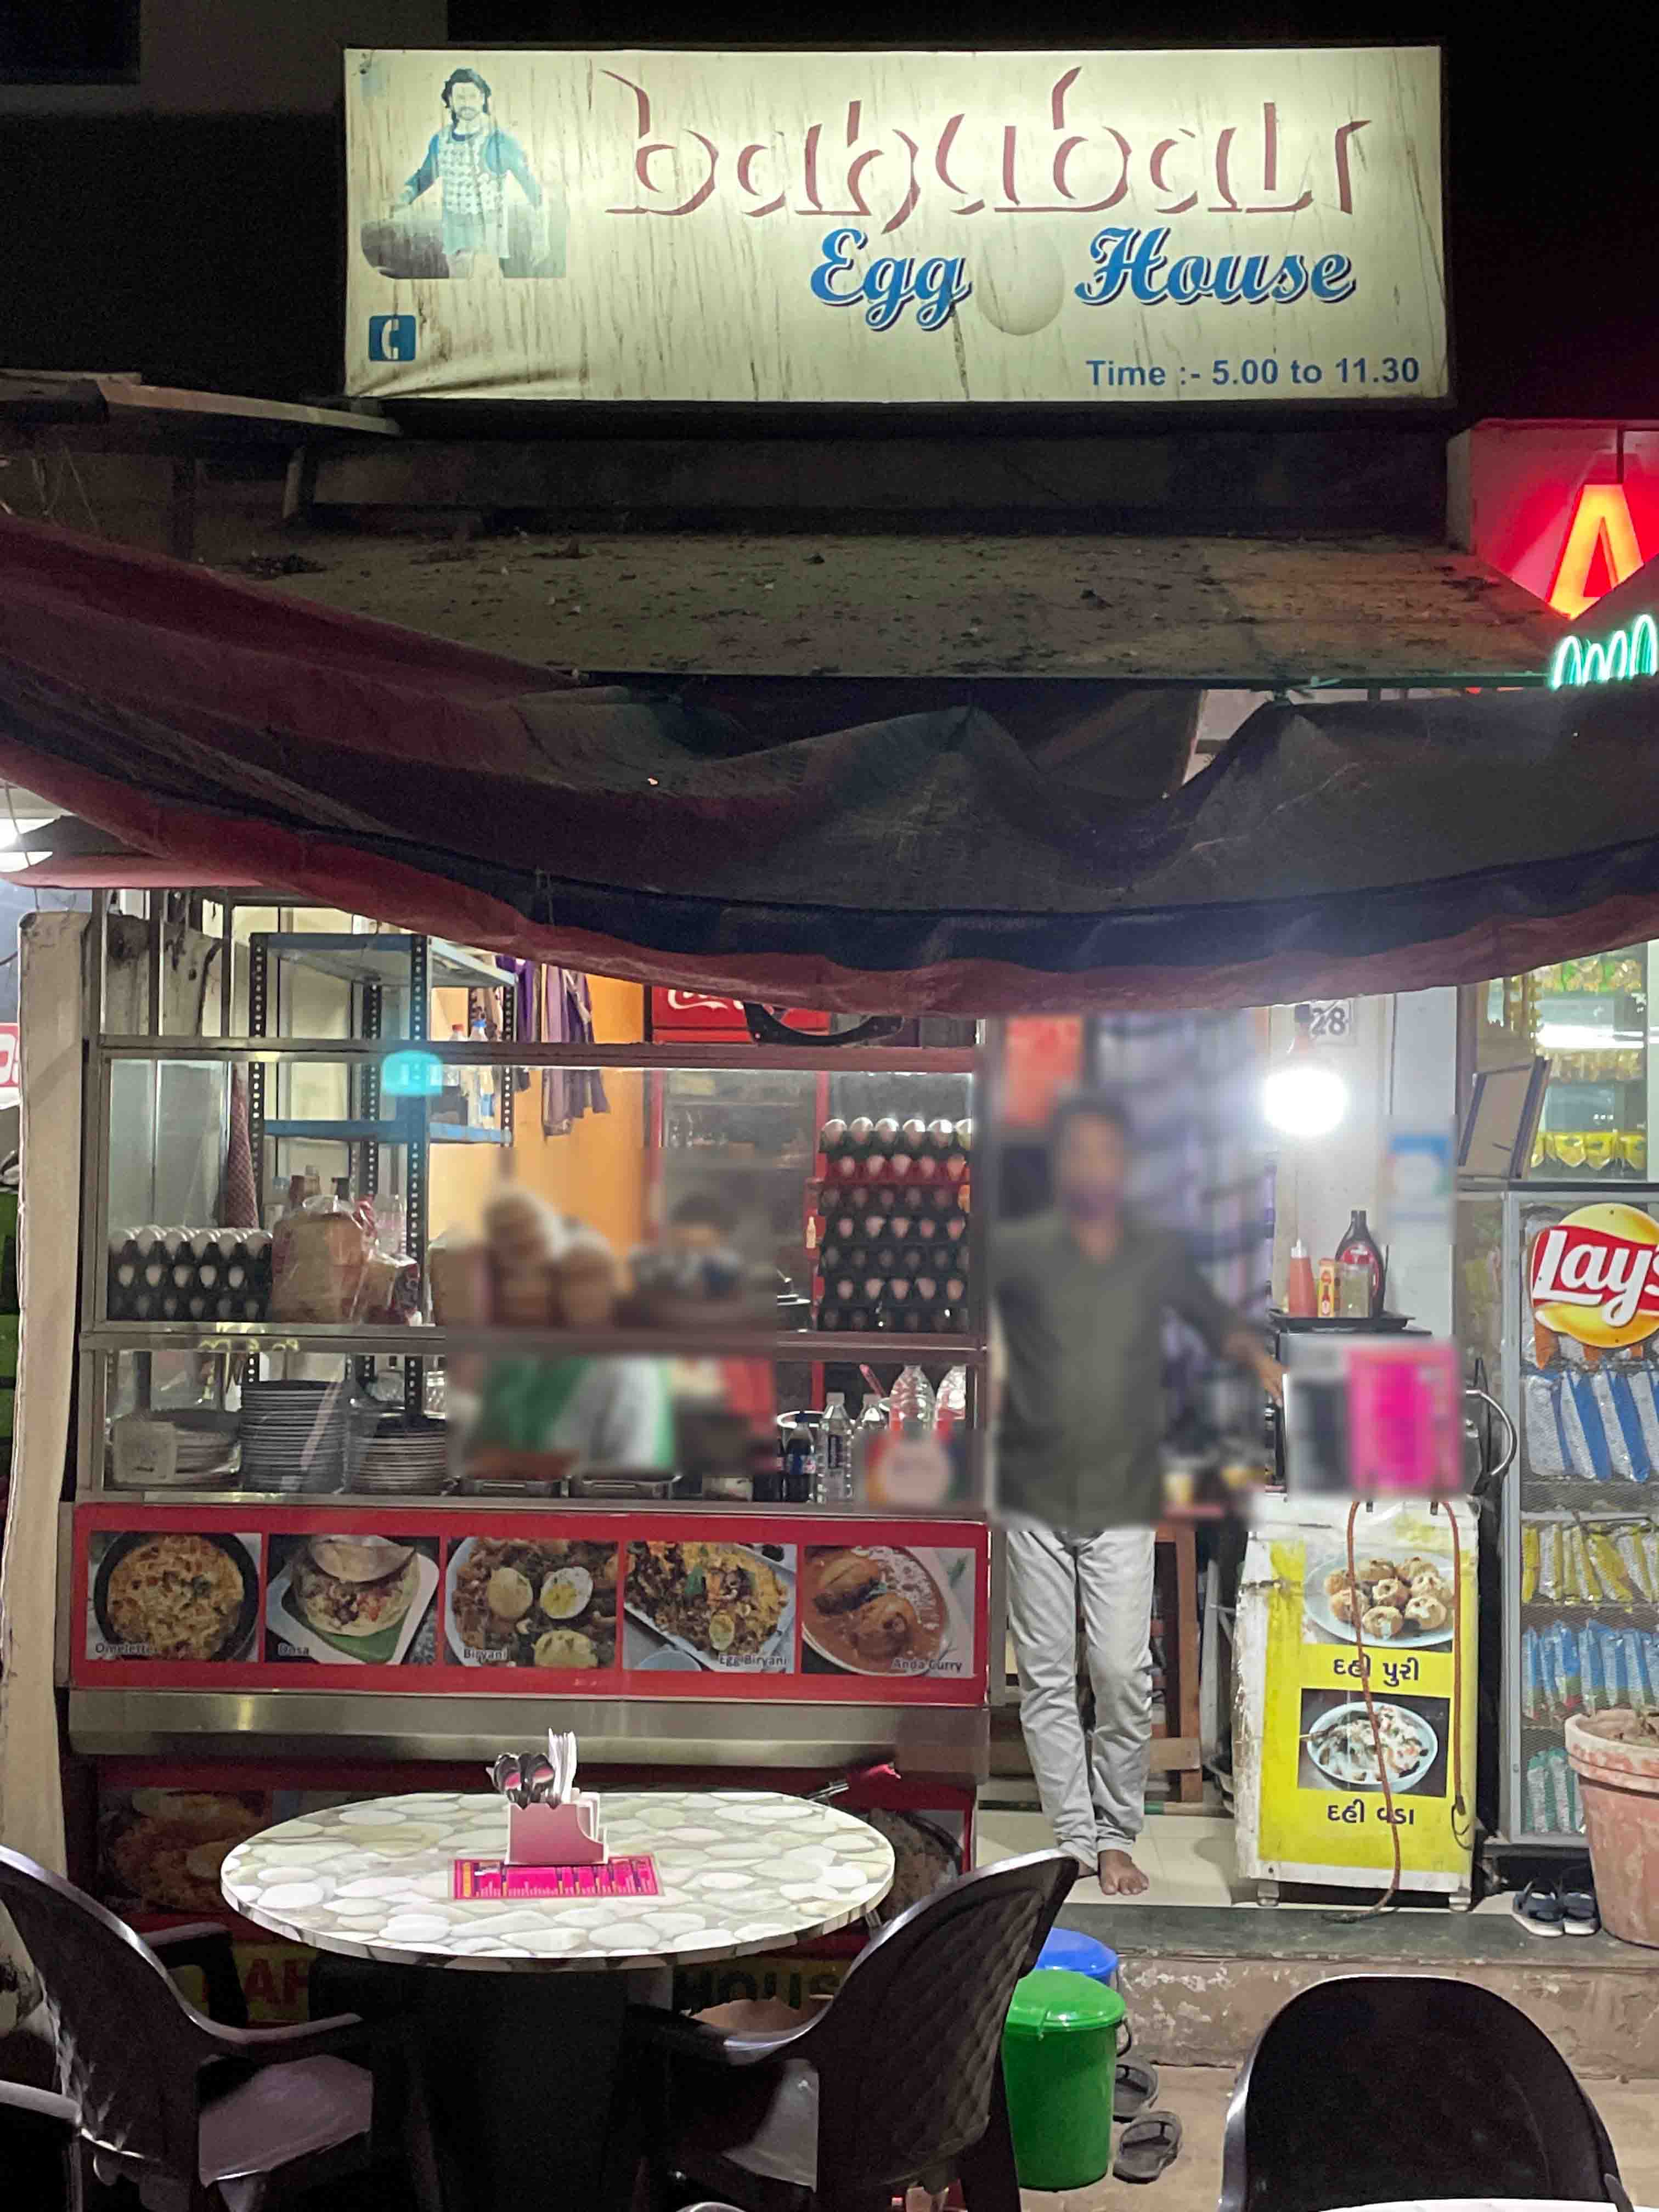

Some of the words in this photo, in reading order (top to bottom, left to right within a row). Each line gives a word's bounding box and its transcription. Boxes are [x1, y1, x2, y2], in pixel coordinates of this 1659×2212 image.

[809, 226, 974, 331] Egg
[1074, 225, 1357, 309] House
[1086, 359, 1166, 386] Time
[1211, 358, 1279, 385] 5.00
[1290, 359, 1323, 383] to
[1335, 357, 1420, 383] 11.30
[1311, 1006, 1346, 1036] 28
[1531, 1228, 1659, 1329] Lay
[929, 1658, 962, 1673] Curry
[1382, 1656, 1419, 1688] પુરી
